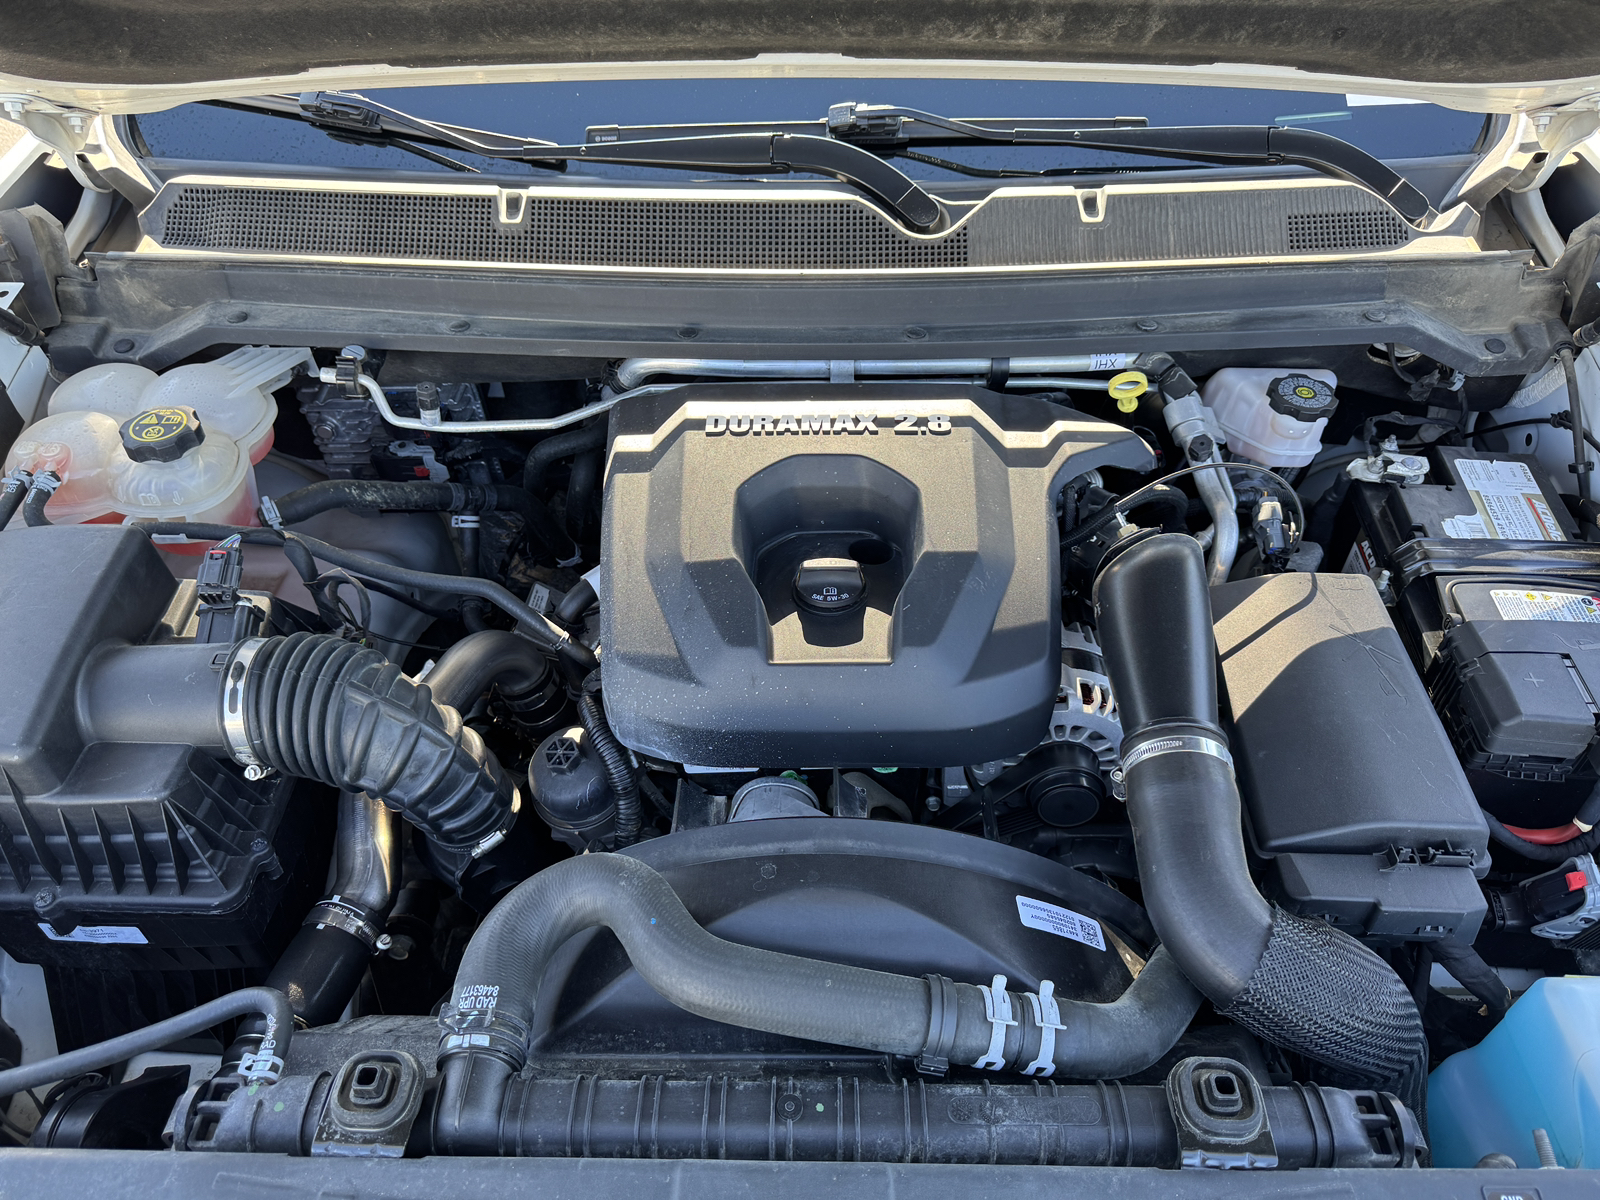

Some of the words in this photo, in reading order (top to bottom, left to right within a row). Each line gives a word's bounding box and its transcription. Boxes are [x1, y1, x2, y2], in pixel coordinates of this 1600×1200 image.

[705, 413, 879, 436] DURAMAX
[894, 413, 952, 436] 2.8
[1532, 499, 1562, 541] ACDelc
[811, 593, 825, 601] SAE
[460, 984, 500, 998] 84463177
[458, 996, 476, 1009] UPR
[475, 996, 498, 1009] RAD
